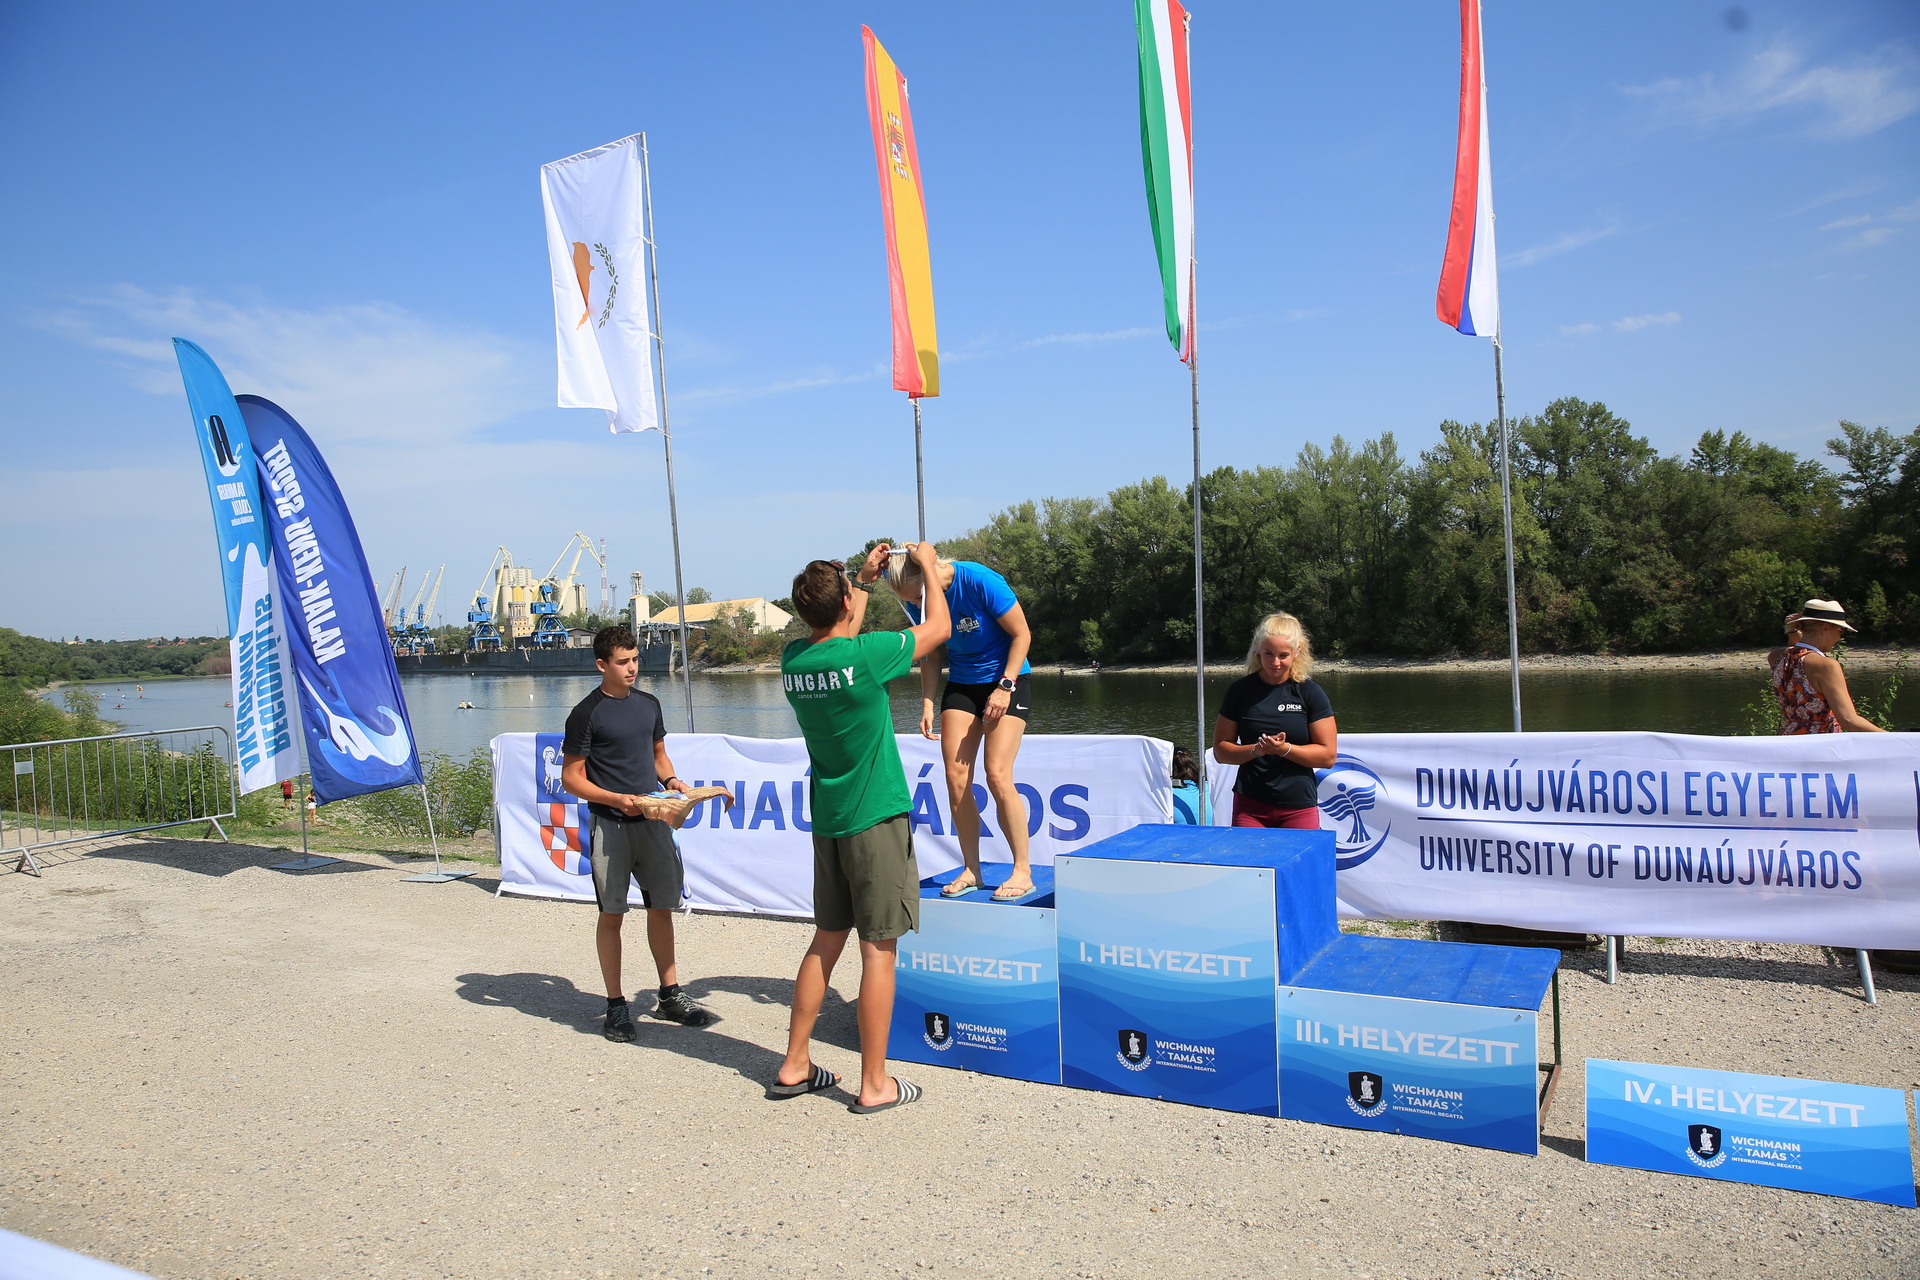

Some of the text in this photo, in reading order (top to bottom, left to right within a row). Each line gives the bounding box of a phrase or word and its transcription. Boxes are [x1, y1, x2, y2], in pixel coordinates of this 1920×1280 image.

[783, 666, 855, 692] UNGARY
[1416, 758, 1859, 819] DUNAÚJVÁROSI EGYETEM
[1419, 835, 1862, 890] UNIVERSITY OF DUNAÚJVÁROS
[911, 950, 1042, 983] HELYEZETT
[1079, 941, 1252, 978] I. HELYEZETT
[956, 1022, 1007, 1036] WICHMANN
[957, 1041, 988, 1050] INTERNATIONAL
[966, 1033, 997, 1044] TAMÁS
[1296, 1019, 1519, 1065] III. HELYEZETT
[1154, 1040, 1215, 1055] WICHMANN
[1156, 1060, 1193, 1070] INTERNATIONAL
[1167, 1052, 1203, 1064] TAMÁS
[1392, 1083, 1463, 1101] WICHMANN
[1406, 1096, 1449, 1110] TAMÁS
[1625, 1080, 1865, 1128] IV. HELYEZETT
[1392, 1105, 1464, 1120] INTERNATIONAL REGATTA
[1730, 1135, 1801, 1152] WICHMANN
[1744, 1147, 1787, 1161] TAMÁS
[1731, 1156, 1803, 1170] INTERNATIONAL REGATTA
